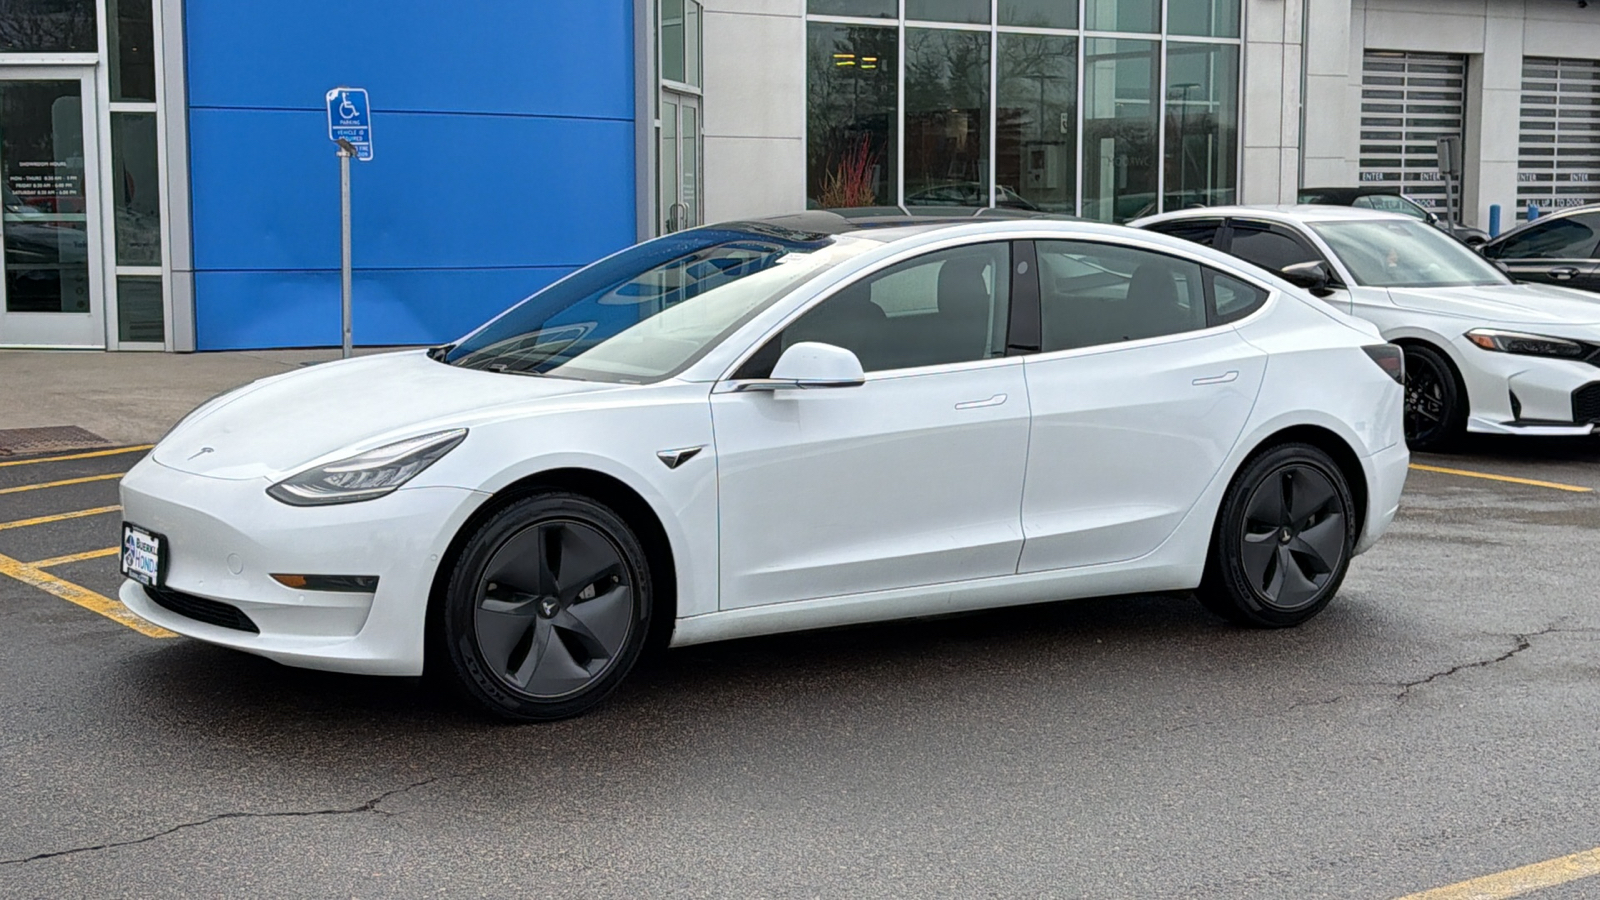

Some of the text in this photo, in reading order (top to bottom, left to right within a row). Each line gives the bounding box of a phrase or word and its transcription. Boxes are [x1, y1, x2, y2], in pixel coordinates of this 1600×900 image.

[1362, 172, 1384, 180] ENTER
[1420, 172, 1440, 180] ENTER
[1518, 172, 1536, 180] ENTER
[1542, 199, 1550, 207] UP
[136, 537, 158, 555] BUERKL
